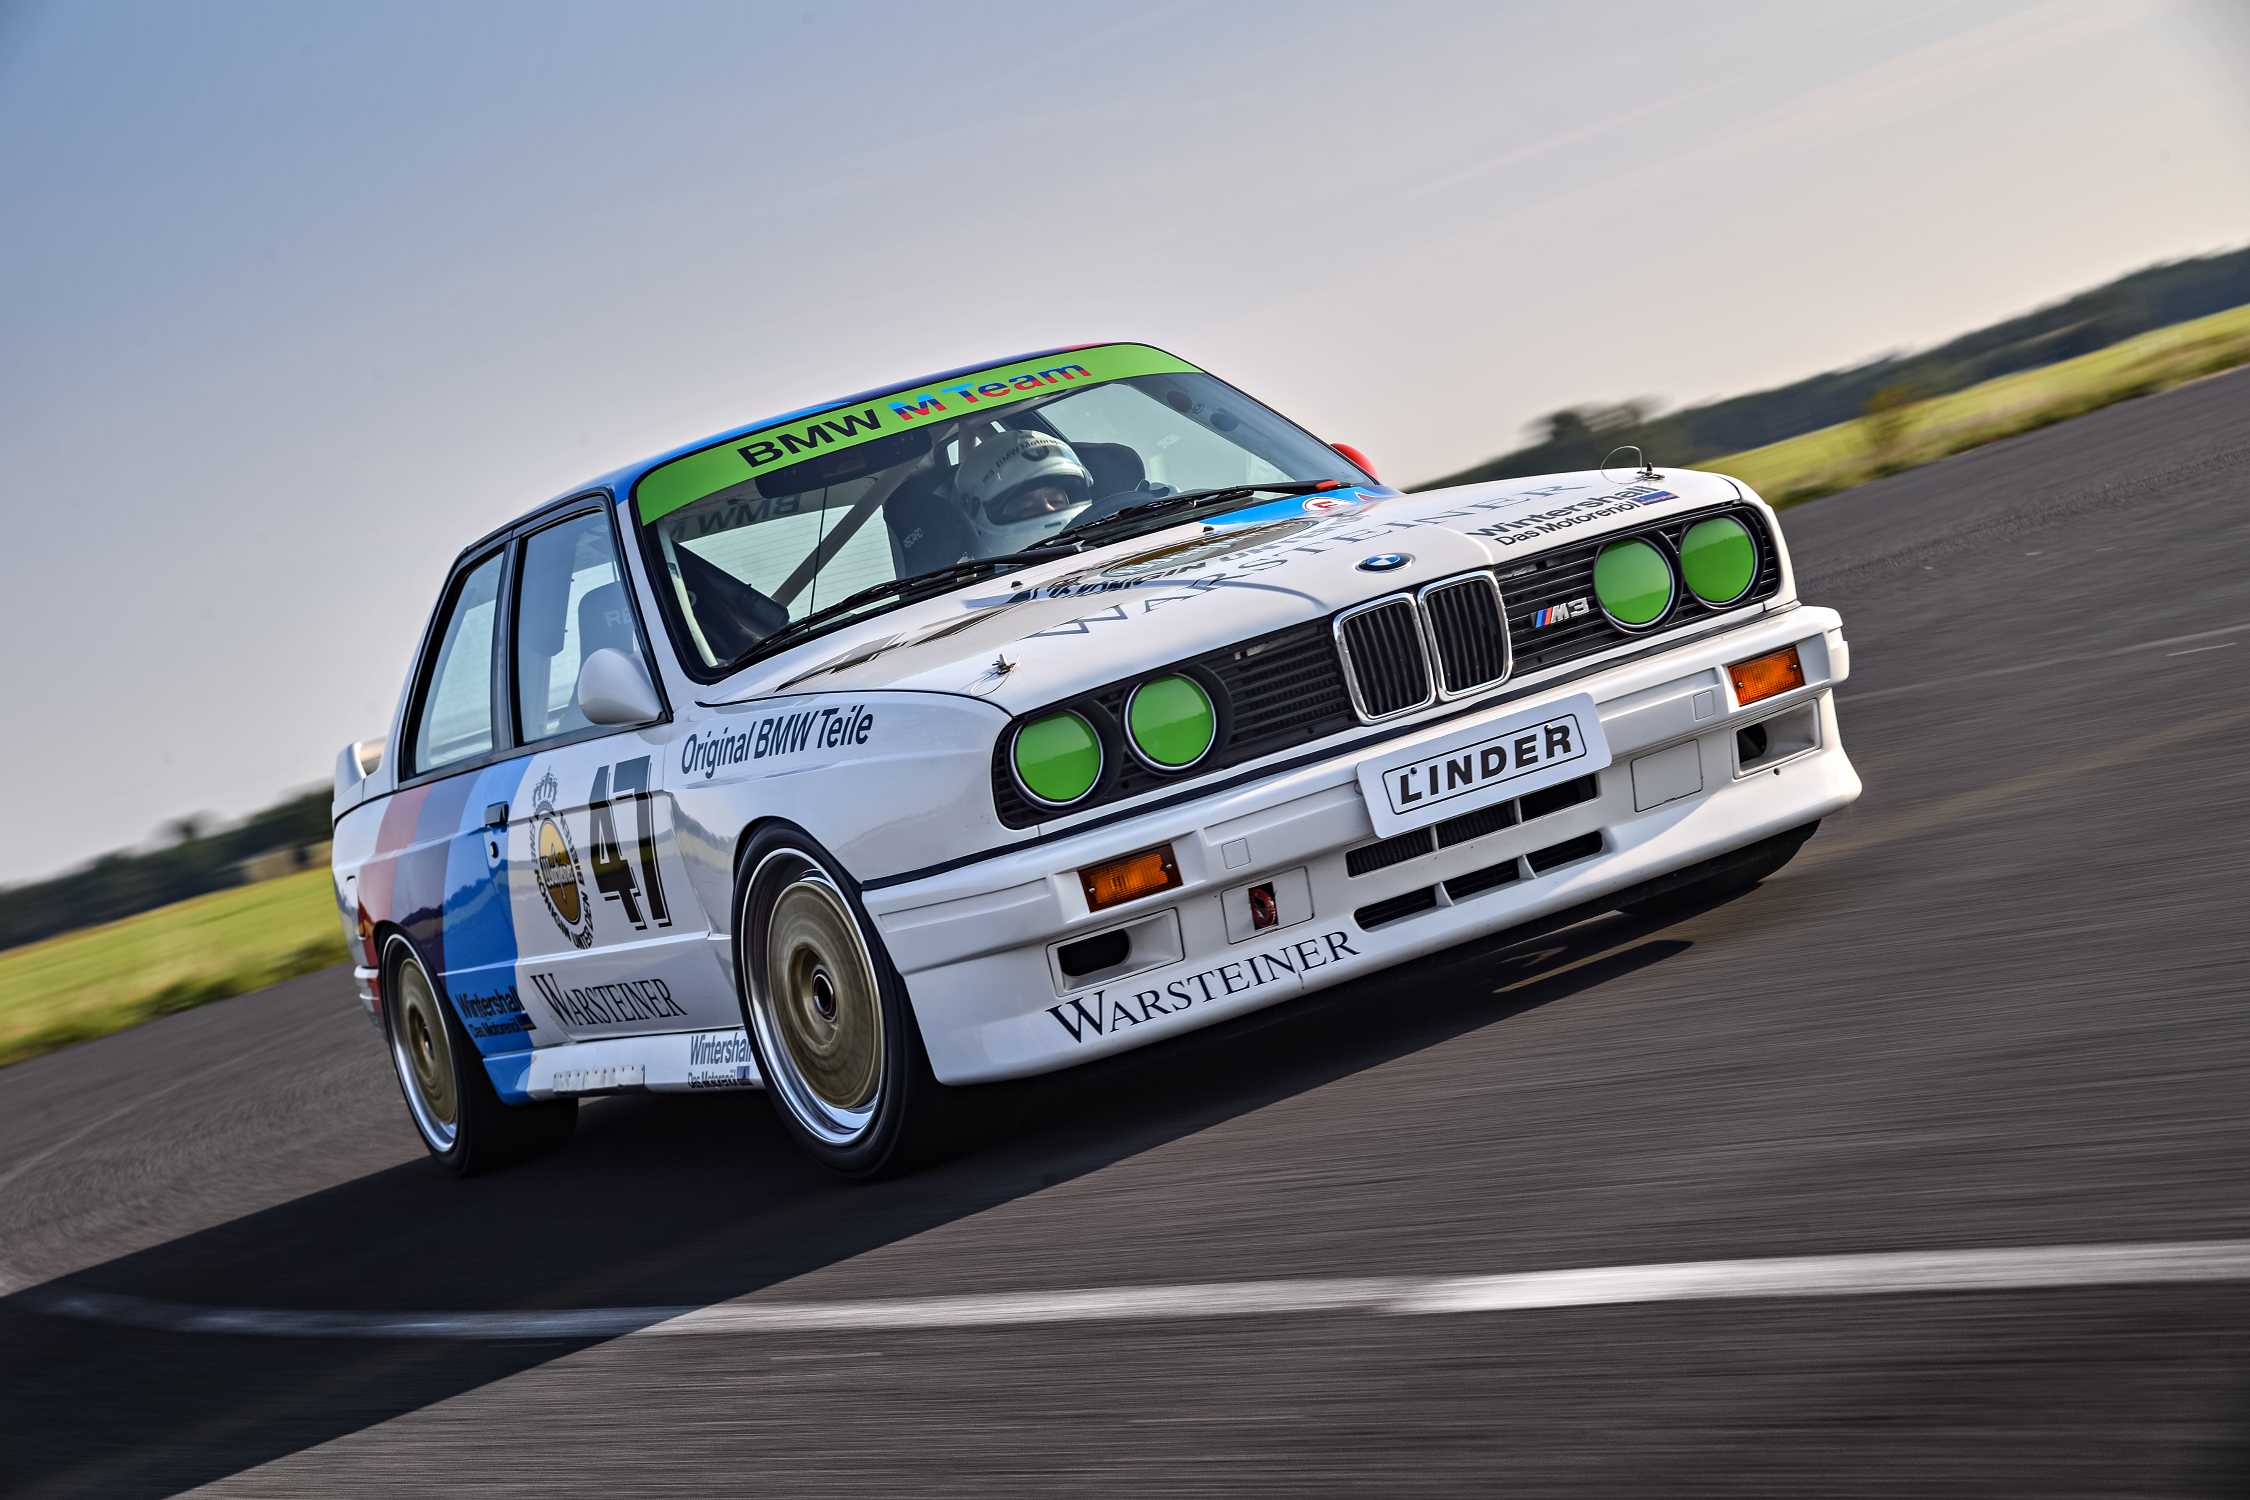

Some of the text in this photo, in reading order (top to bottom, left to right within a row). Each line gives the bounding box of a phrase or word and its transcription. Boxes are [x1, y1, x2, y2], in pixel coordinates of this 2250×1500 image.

[737, 363, 1092, 468] BMW M Team
[1465, 485, 1661, 537] Wintershall
[1494, 500, 1641, 546] Das Motorenöl
[1016, 485, 1592, 641] WARSTEINER
[1550, 596, 1590, 624] M3
[682, 704, 874, 779] Original BMW Teile
[1400, 724, 1572, 805] LINDER
[589, 754, 673, 931] 47
[455, 985, 526, 1018] Wintershall
[530, 972, 689, 1027] WARSTEINER
[1045, 930, 1361, 1044] WARSTEINER
